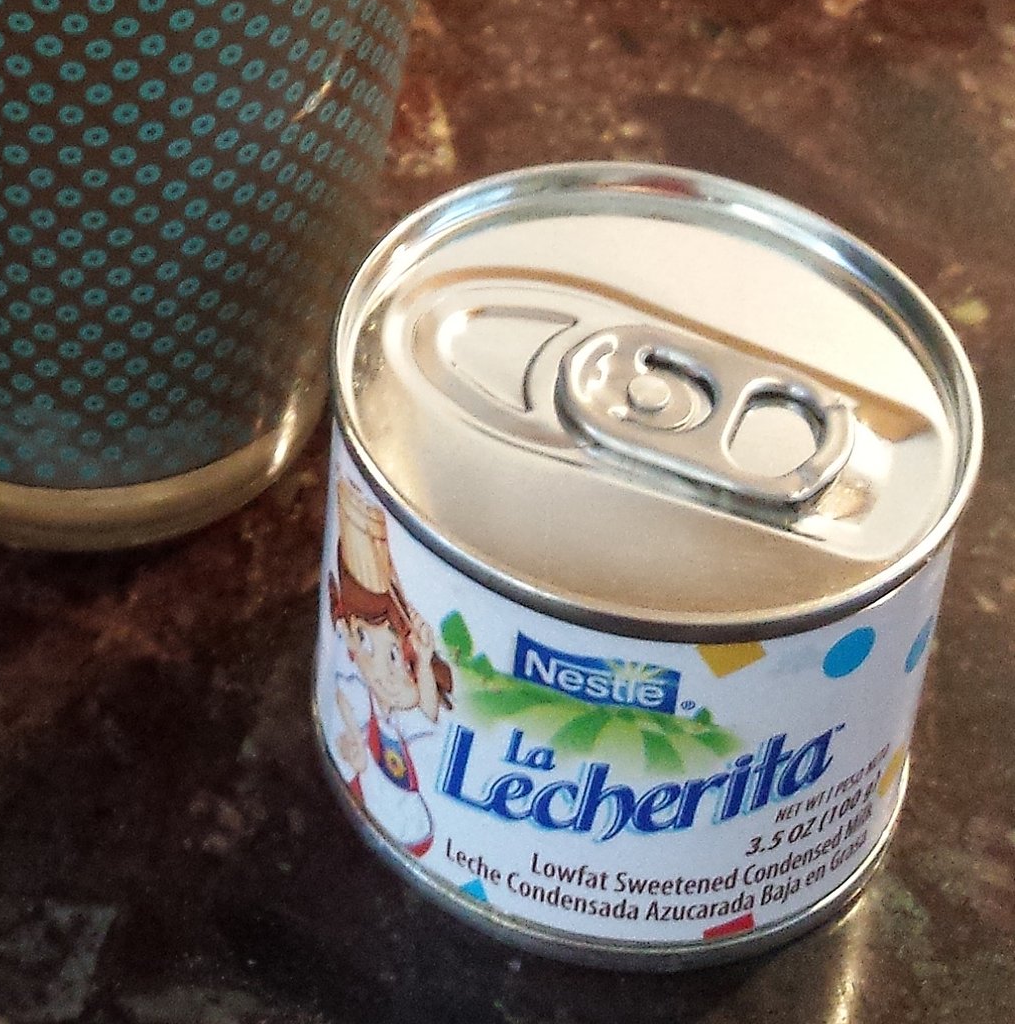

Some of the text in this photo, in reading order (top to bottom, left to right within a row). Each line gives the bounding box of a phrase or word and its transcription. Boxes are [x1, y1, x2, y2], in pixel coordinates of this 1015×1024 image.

[439, 722, 835, 842] Lecherita
[504, 727, 556, 771] La
[745, 829, 785, 858] 3.5
[788, 816, 817, 844] OZ
[819, 788, 862, 833] (100
[775, 802, 801, 824] NET
[806, 788, 826, 814] WT
[446, 837, 502, 885] Leche
[506, 871, 640, 921] Condensada
[645, 891, 755, 921] Azucarada
[760, 876, 800, 906] Baja
[805, 864, 826, 887] en
[531, 852, 609, 890] Lowfat
[614, 868, 737, 896] Sweetened
[743, 825, 843, 886] Condensed
